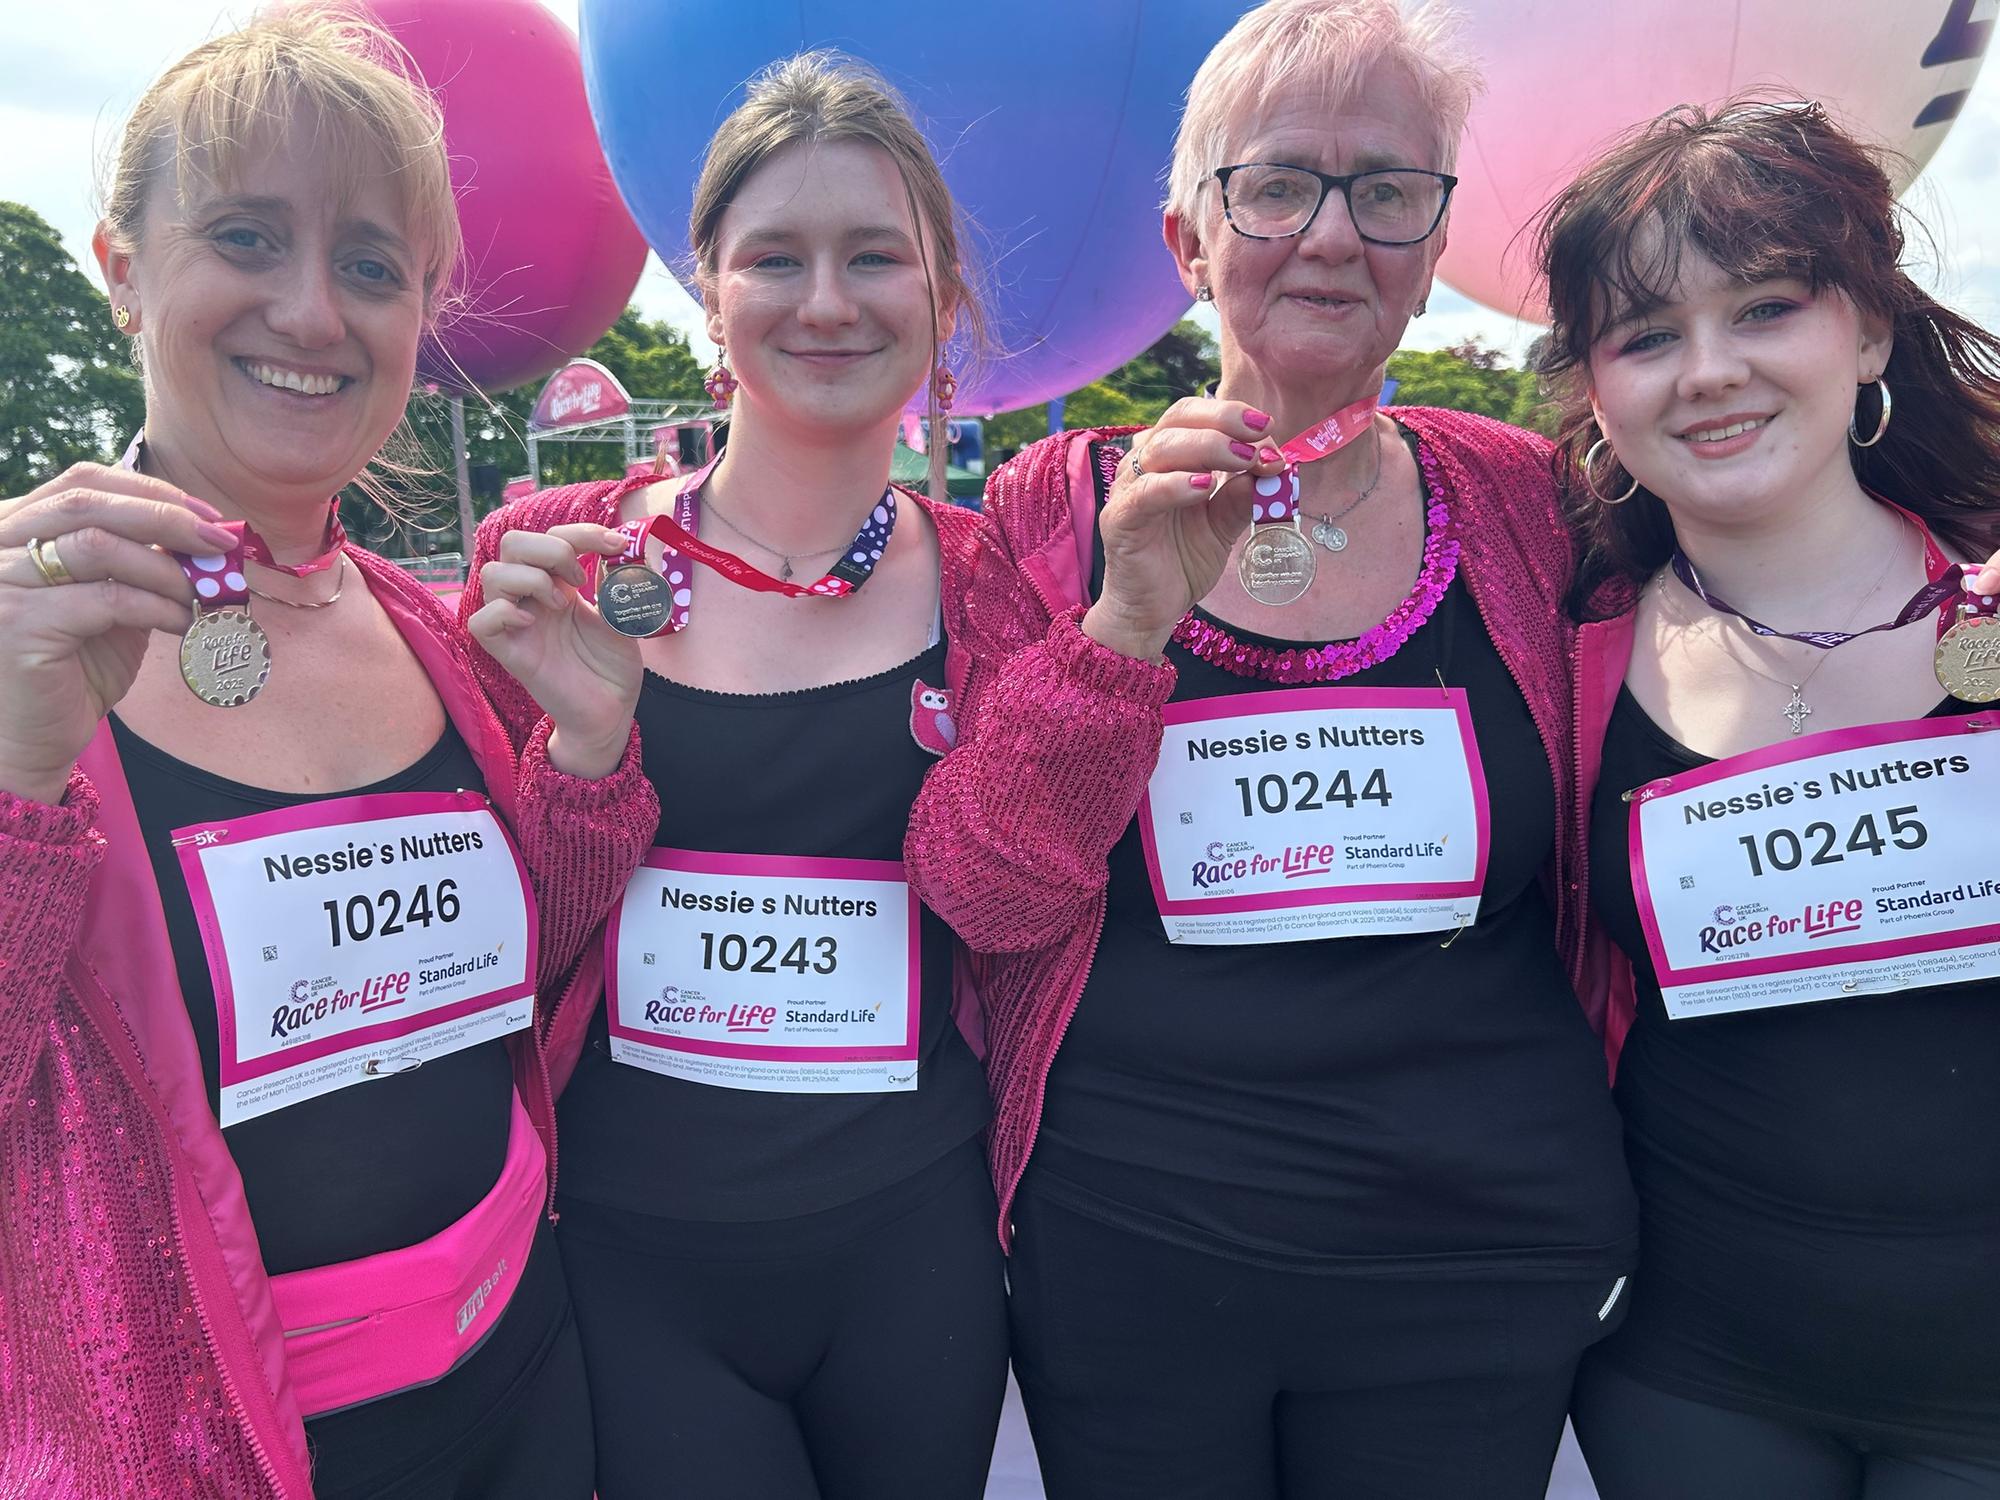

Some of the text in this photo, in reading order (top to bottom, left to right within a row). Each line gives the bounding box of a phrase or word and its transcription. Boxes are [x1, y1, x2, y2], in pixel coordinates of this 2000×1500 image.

[680, 540, 744, 576] Standard Life
[202, 632, 249, 651] Race for
[1958, 636, 1990, 651] Race
[212, 643, 252, 672] Life
[216, 678, 244, 691] 2025
[1963, 677, 1994, 688] 2025
[1187, 725, 1425, 762] Nessie s Nutters
[1829, 755, 1970, 796] Nutters
[1234, 768, 1393, 817] 10244
[400, 831, 484, 862] Nutters
[1345, 842, 1443, 860] Standard Life
[1738, 805, 1928, 877] 10245
[1192, 844, 1334, 889] Race for Life
[1872, 880, 1926, 893] Proud Partner
[1875, 885, 1965, 913] Standard
[323, 878, 461, 948] 10246
[661, 887, 877, 917] Nessie s Nutters
[1735, 902, 1761, 911] CANCER
[1736, 906, 1769, 916] RESEARCH
[1880, 917, 1895, 925] Part
[1904, 912, 1932, 921] Phoenix
[1932, 908, 1955, 917] Group
[1698, 899, 1863, 954] Race for Life
[418, 952, 454, 965] Proud Partner
[700, 932, 838, 975] 10243
[311, 976, 332, 986] CANCER
[419, 952, 498, 985] Standard Life
[1678, 990, 1705, 999] Cancer
[1706, 985, 1741, 995] Research
[1765, 976, 1804, 988] registered
[1804, 972, 1831, 983] charity
[1832, 972, 1840, 980] in
[1841, 966, 1873, 977] England
[1874, 965, 1891, 973] and
[1892, 961, 1916, 971] Wales
[1958, 951, 1997, 961] Scotland
[311, 980, 338, 992] RESEARCH
[418, 988, 430, 996] Part
[434, 983, 453, 992] Phoenix
[453, 979, 466, 989] Group
[1681, 998, 1693, 1006] the
[1693, 997, 1706, 1005] Isle
[1715, 995, 1731, 1003] Man
[1768, 986, 1792, 996] Jersey
[1822, 979, 1851, 988] Cancer
[1852, 975, 1889, 984] Research
[1889, 973, 1901, 981] UK
[271, 971, 411, 1038] Race for Life
[644, 1000, 777, 1027] Race for Life
[785, 1009, 875, 1023] Standard Life
[236, 1087, 262, 1099] Cancer
[263, 1074, 294, 1090] Research
[295, 1072, 303, 1080] UK
[316, 1058, 348, 1074] registered
[348, 1052, 371, 1064] charity
[371, 1049, 378, 1057] in
[236, 1098, 249, 1109] the
[249, 1095, 261, 1106] Isle
[262, 1092, 269, 1101] of
[269, 1088, 284, 1097] Man
[302, 1078, 316, 1087] and
[316, 1071, 337, 1084] Jersey
